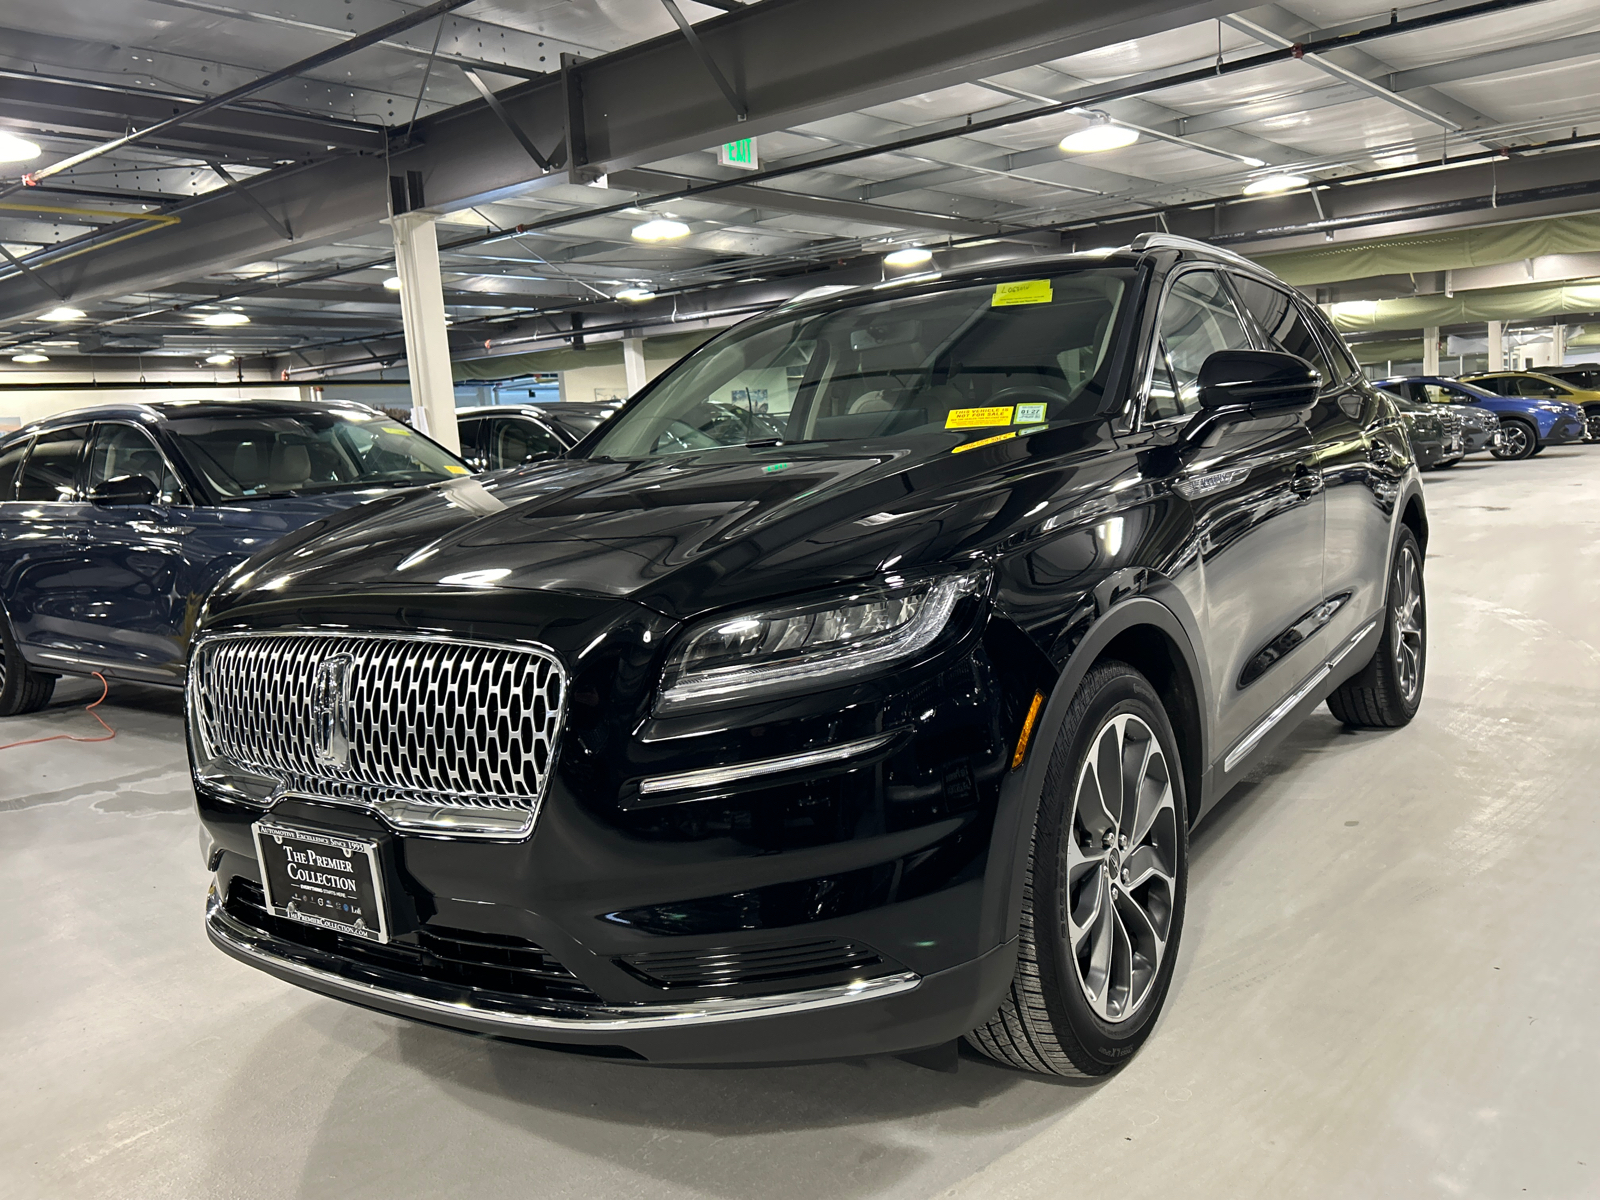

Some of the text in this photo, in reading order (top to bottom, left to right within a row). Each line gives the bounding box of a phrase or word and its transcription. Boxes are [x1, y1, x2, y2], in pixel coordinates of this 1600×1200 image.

[728, 137, 752, 164] EXIT
[260, 826, 295, 838] AUTOMOTIVE
[296, 831, 329, 844] EXCELLENCE
[283, 845, 354, 873] THE PREMIER
[287, 862, 357, 892] COLLECTION
